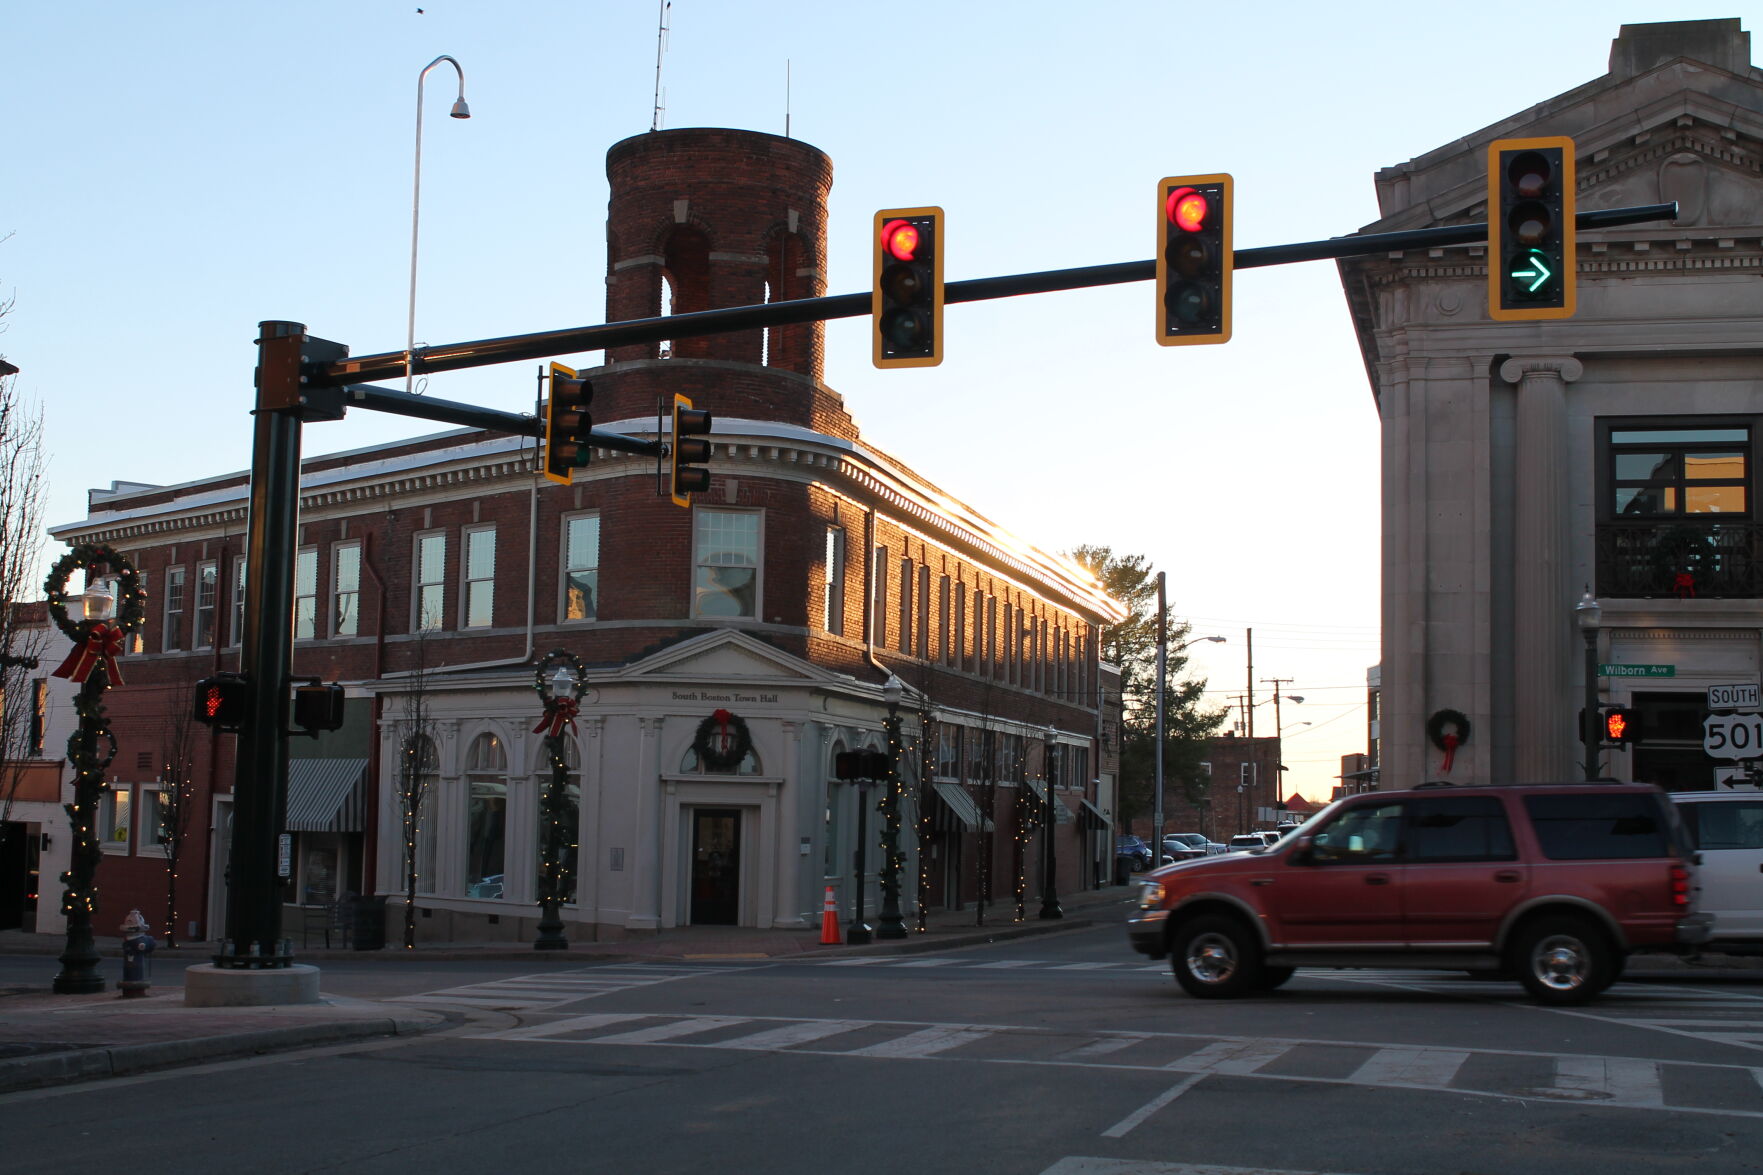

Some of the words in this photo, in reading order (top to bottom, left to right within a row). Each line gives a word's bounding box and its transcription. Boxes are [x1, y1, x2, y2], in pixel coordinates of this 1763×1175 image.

[1605, 665, 1645, 675] Wilborn
[672, 691, 697, 701] South
[701, 692, 731, 702] Boston
[734, 693, 757, 703] Town
[760, 694, 778, 703] Hall
[1712, 689, 1757, 704] SOUTH
[1708, 723, 1762, 750] 501
